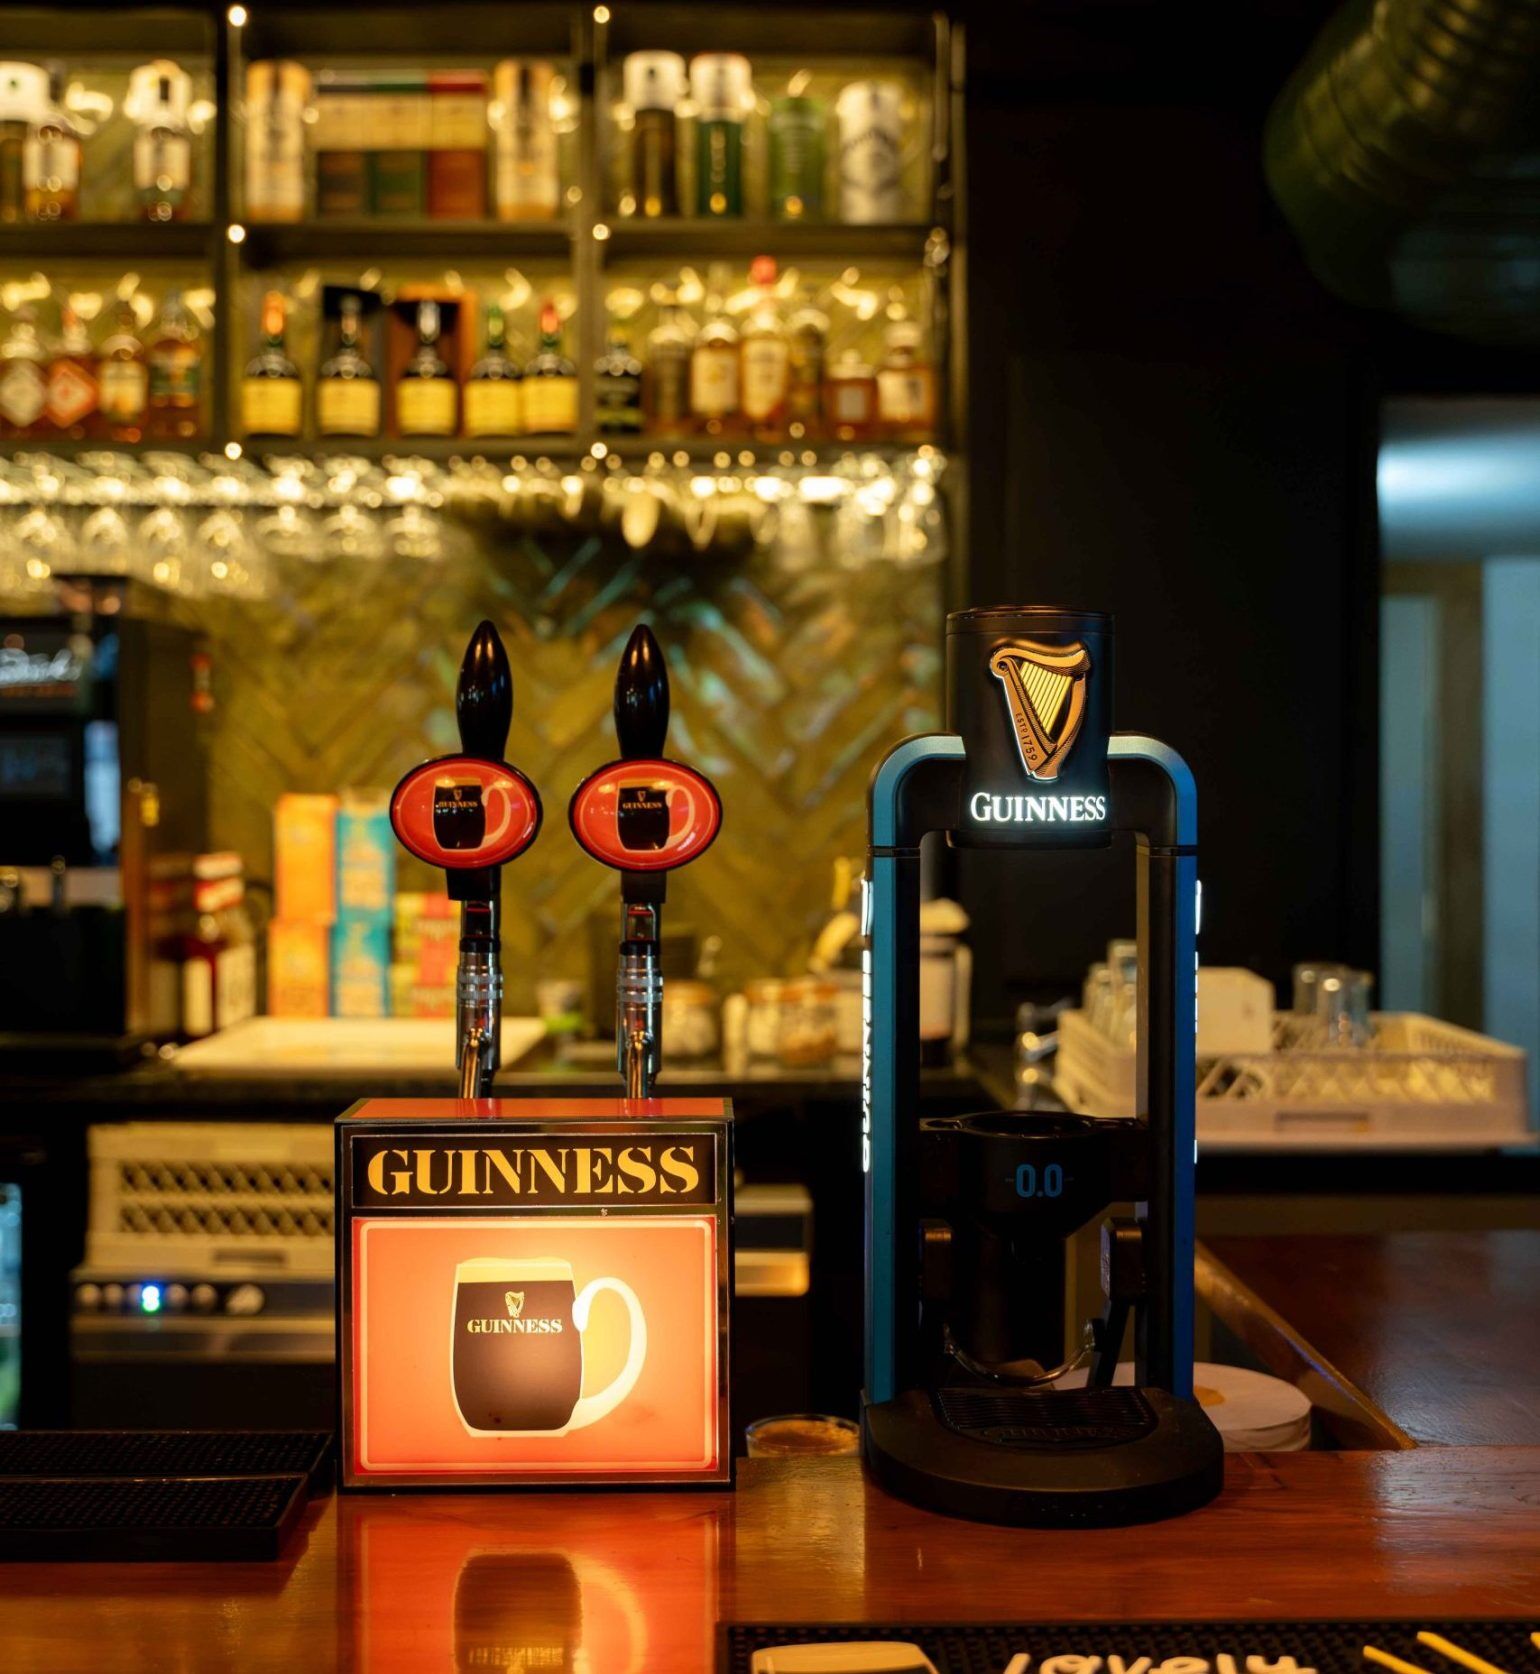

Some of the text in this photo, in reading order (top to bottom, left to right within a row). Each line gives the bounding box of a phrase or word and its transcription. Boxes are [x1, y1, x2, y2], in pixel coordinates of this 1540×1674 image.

[1021, 735, 1038, 761] 1759
[970, 792, 1106, 822] GUINNESS
[367, 1146, 699, 1196] GUINNESS
[1016, 1163, 1063, 1198] 0.0
[467, 1319, 563, 1334] GUINNESS
